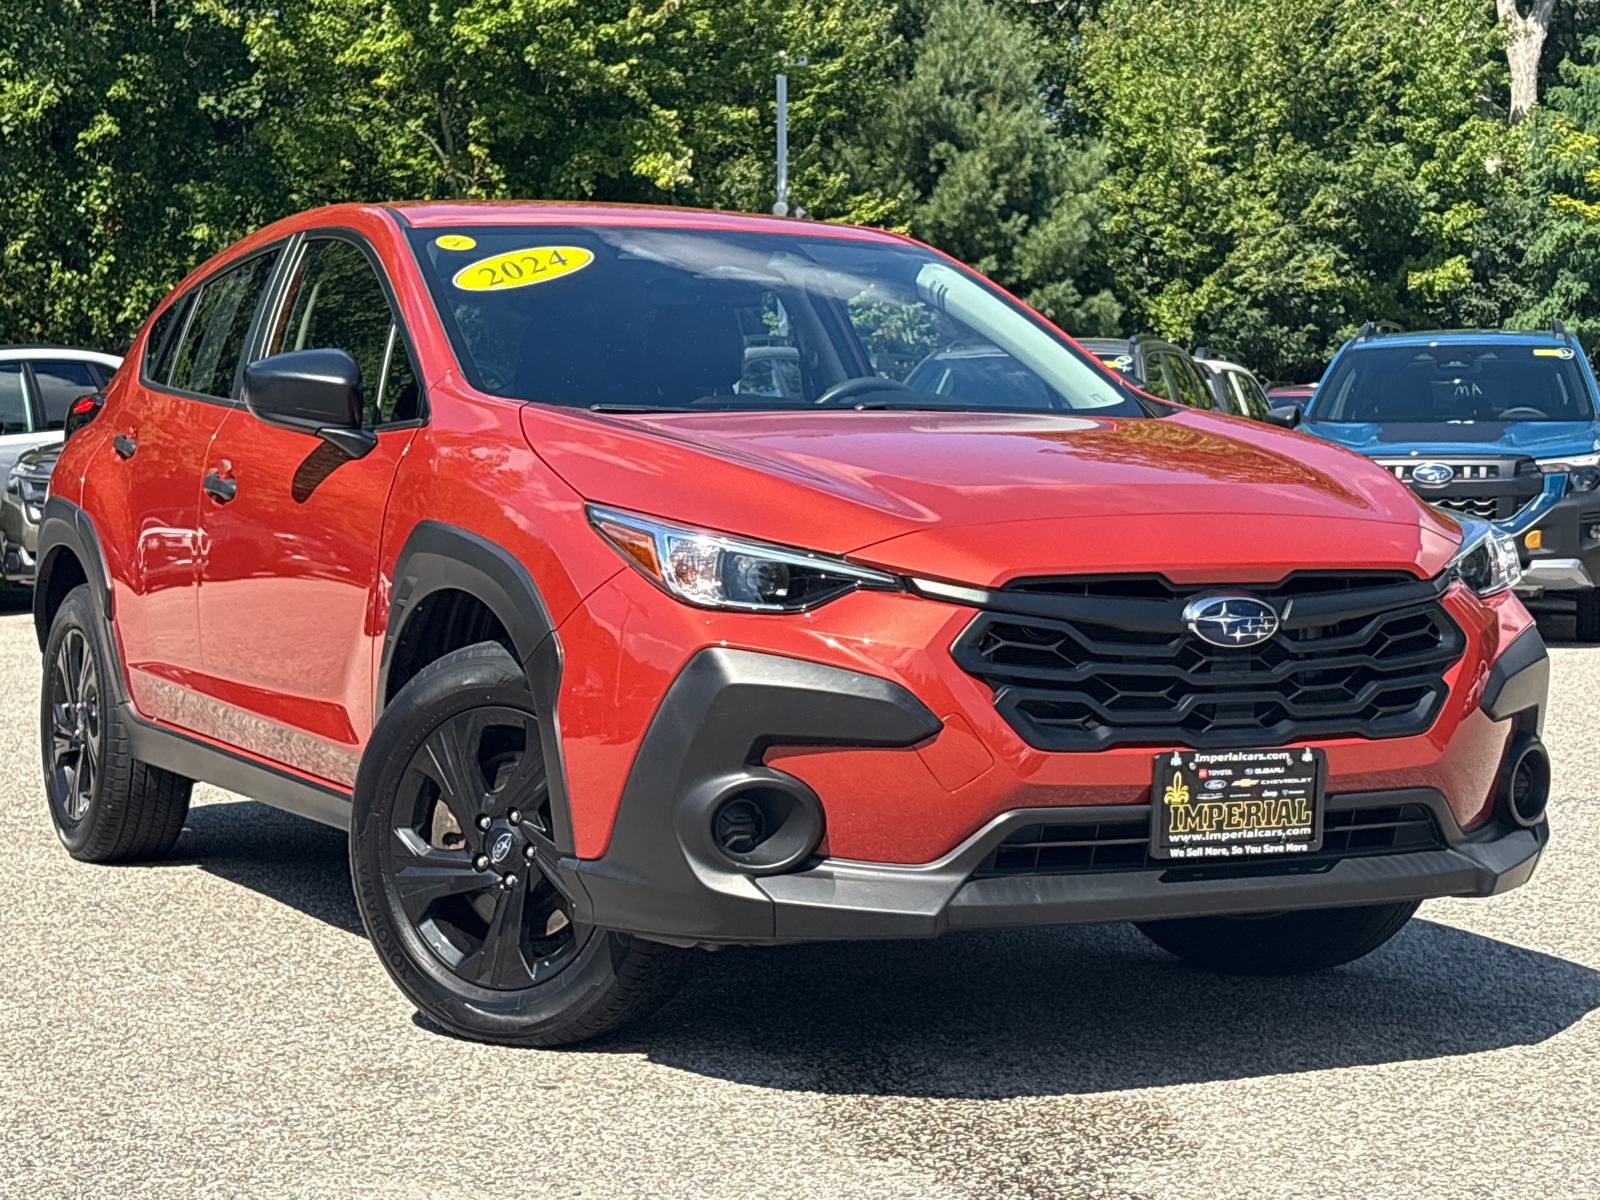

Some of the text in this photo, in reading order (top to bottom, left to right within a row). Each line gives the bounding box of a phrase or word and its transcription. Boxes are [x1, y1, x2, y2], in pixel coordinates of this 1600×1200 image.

[477, 249, 569, 287] 2024
[1454, 382, 1483, 397] MA
[1194, 751, 1289, 764] Imperialcars.com
[1208, 769, 1233, 777] TOYOTA
[1254, 767, 1285, 775] SUBARU
[1261, 777, 1313, 785] CHEVROLET
[1169, 798, 1312, 833] IMPERIAL
[1169, 827, 1312, 843] www.imperialcars.com
[1169, 842, 1308, 858] We Sell More, So You Save More
[357, 862, 411, 979] YOKOHAMA
